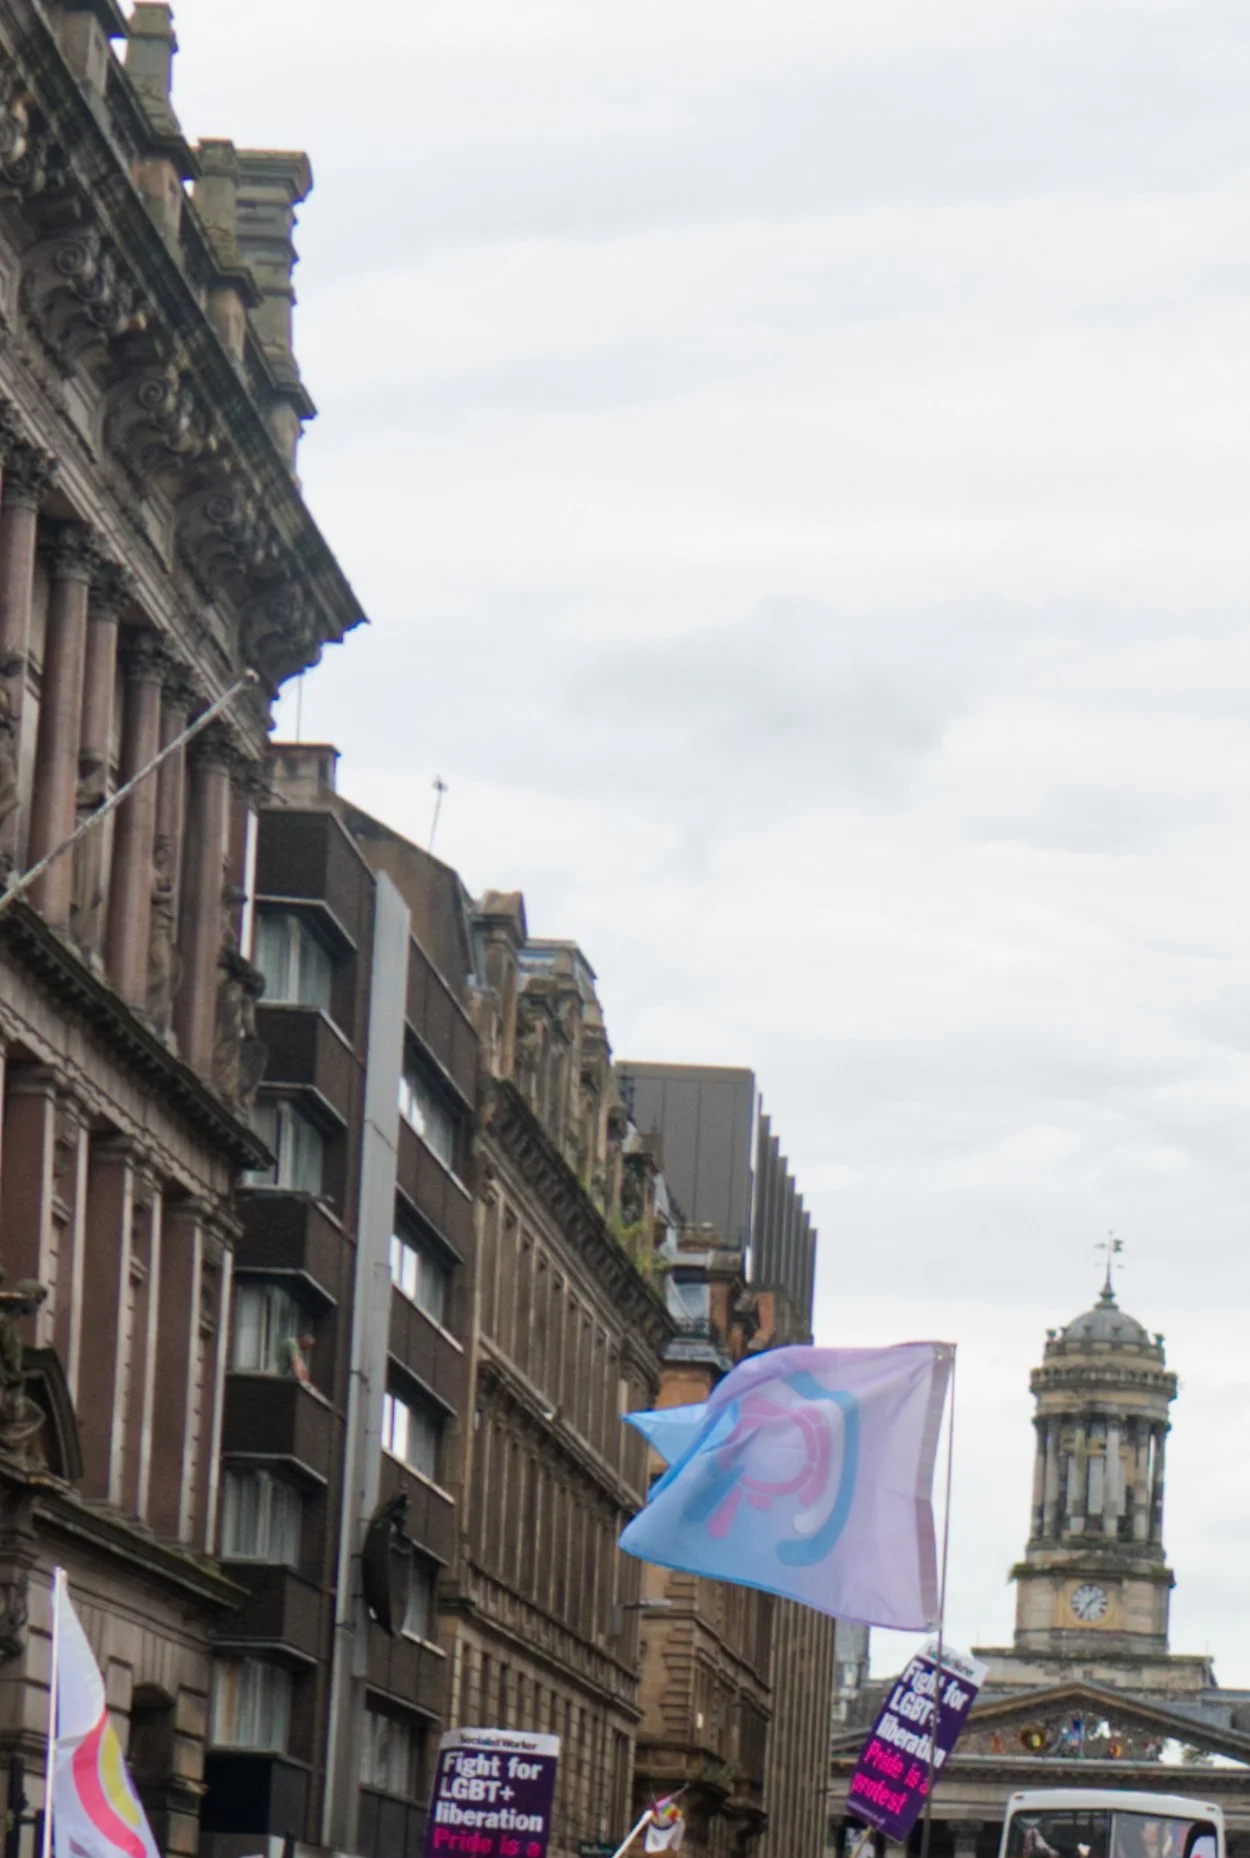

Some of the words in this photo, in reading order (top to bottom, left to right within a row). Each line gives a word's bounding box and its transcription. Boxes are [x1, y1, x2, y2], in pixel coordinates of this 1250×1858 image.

[942, 1680, 970, 1711] for
[443, 1751, 501, 1778] Fight
[508, 1756, 544, 1780] for
[863, 1740, 904, 1779] Pride
[439, 1776, 515, 1802] LGBT+
[852, 1772, 909, 1816] protest
[434, 1801, 545, 1832] liberation
[432, 1827, 493, 1854] Pride
[499, 1833, 521, 1857] is
[527, 1841, 541, 1858] a
